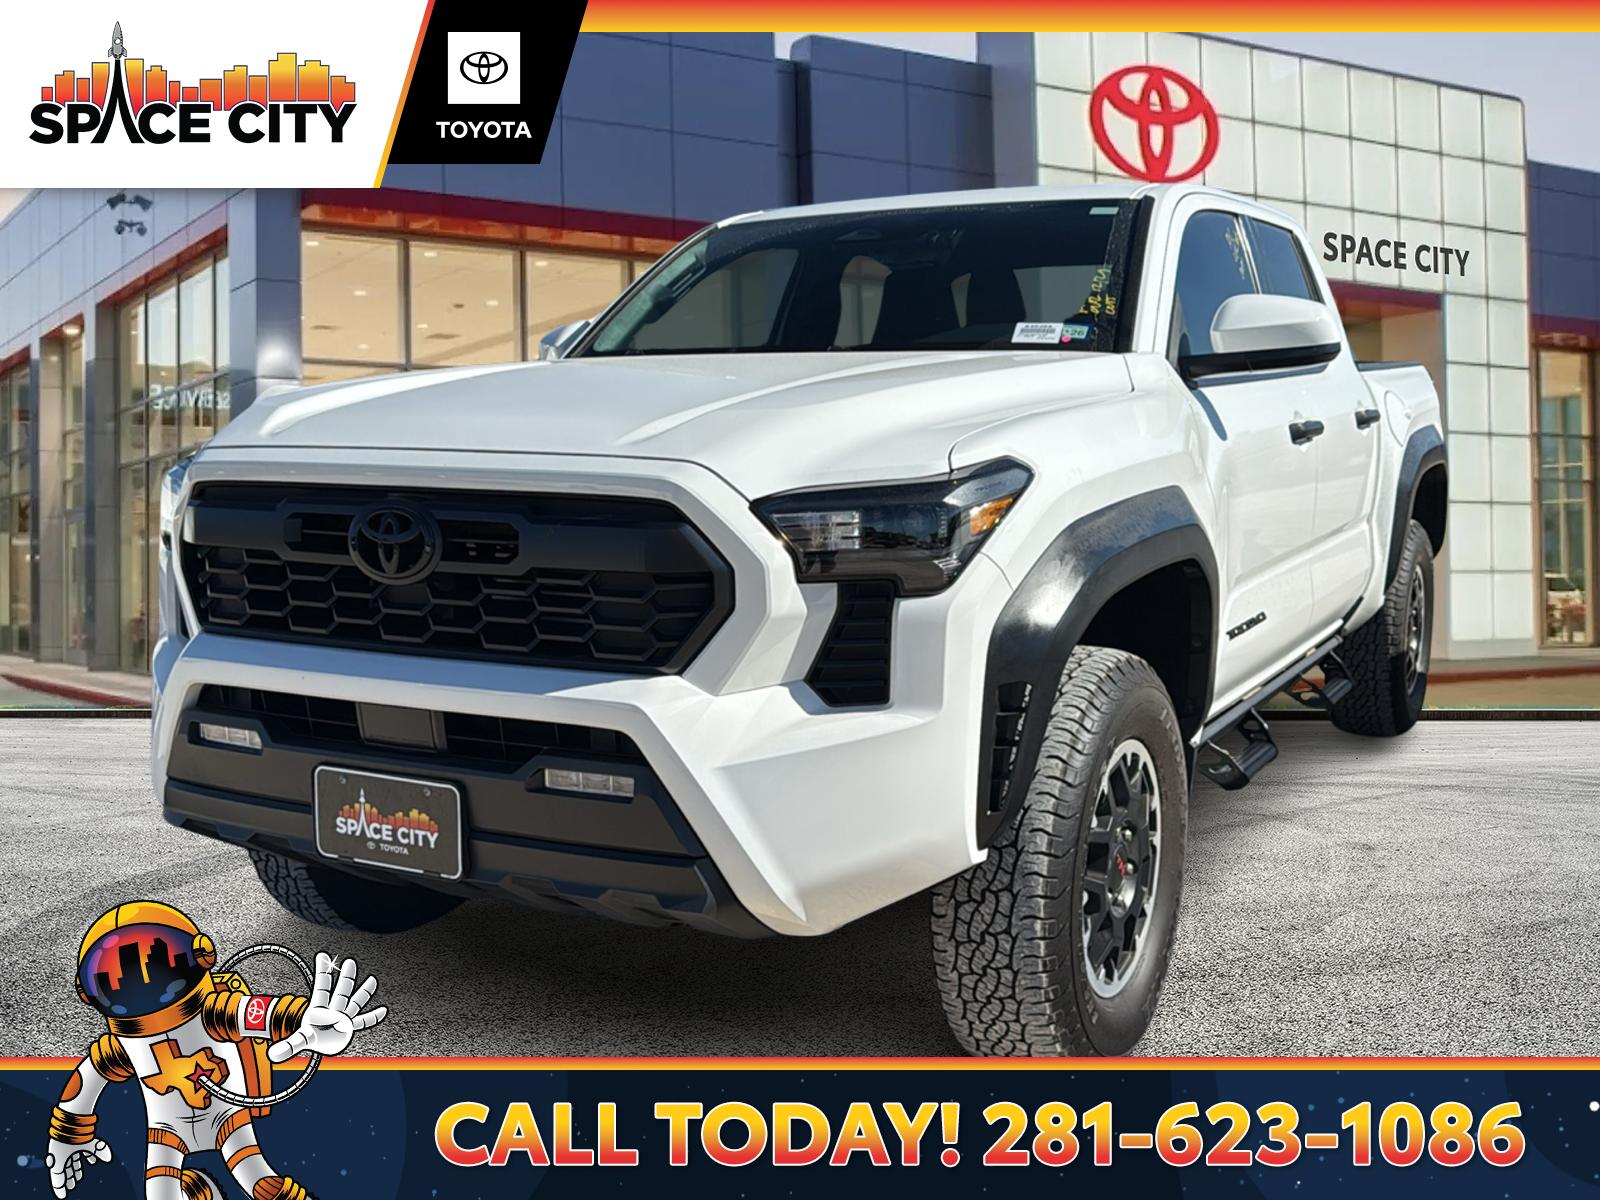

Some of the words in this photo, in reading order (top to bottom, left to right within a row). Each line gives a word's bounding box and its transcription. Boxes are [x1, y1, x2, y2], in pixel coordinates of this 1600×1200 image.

[1323, 232, 1407, 269] SPACE
[1415, 244, 1470, 276] CITY
[336, 803, 393, 841] SPACE
[397, 826, 439, 848] CITY
[379, 842, 409, 855] TOYOTA
